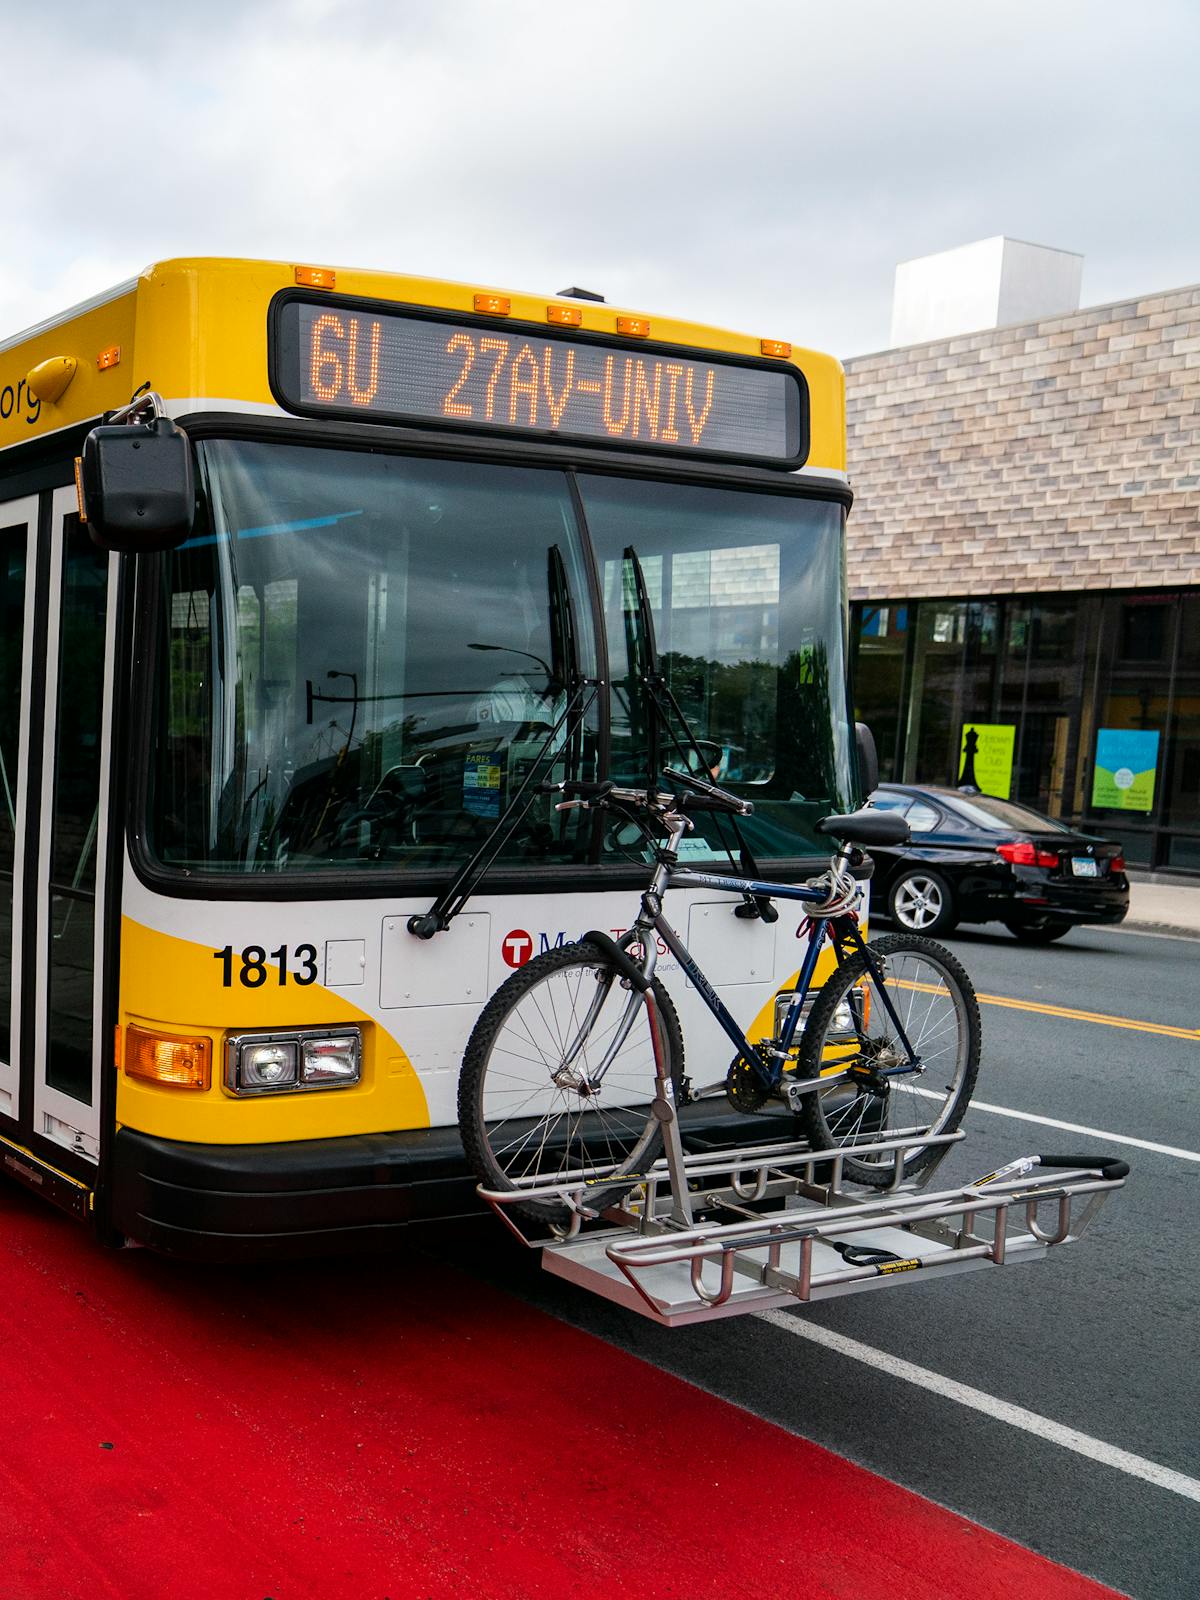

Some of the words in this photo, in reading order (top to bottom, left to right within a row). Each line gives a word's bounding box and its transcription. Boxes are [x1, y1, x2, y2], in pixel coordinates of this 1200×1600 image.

[310, 313, 382, 407] 6U
[442, 332, 715, 446] 27AV-UNIV
[465, 754, 492, 764] FARES
[212, 942, 320, 989] 1813
